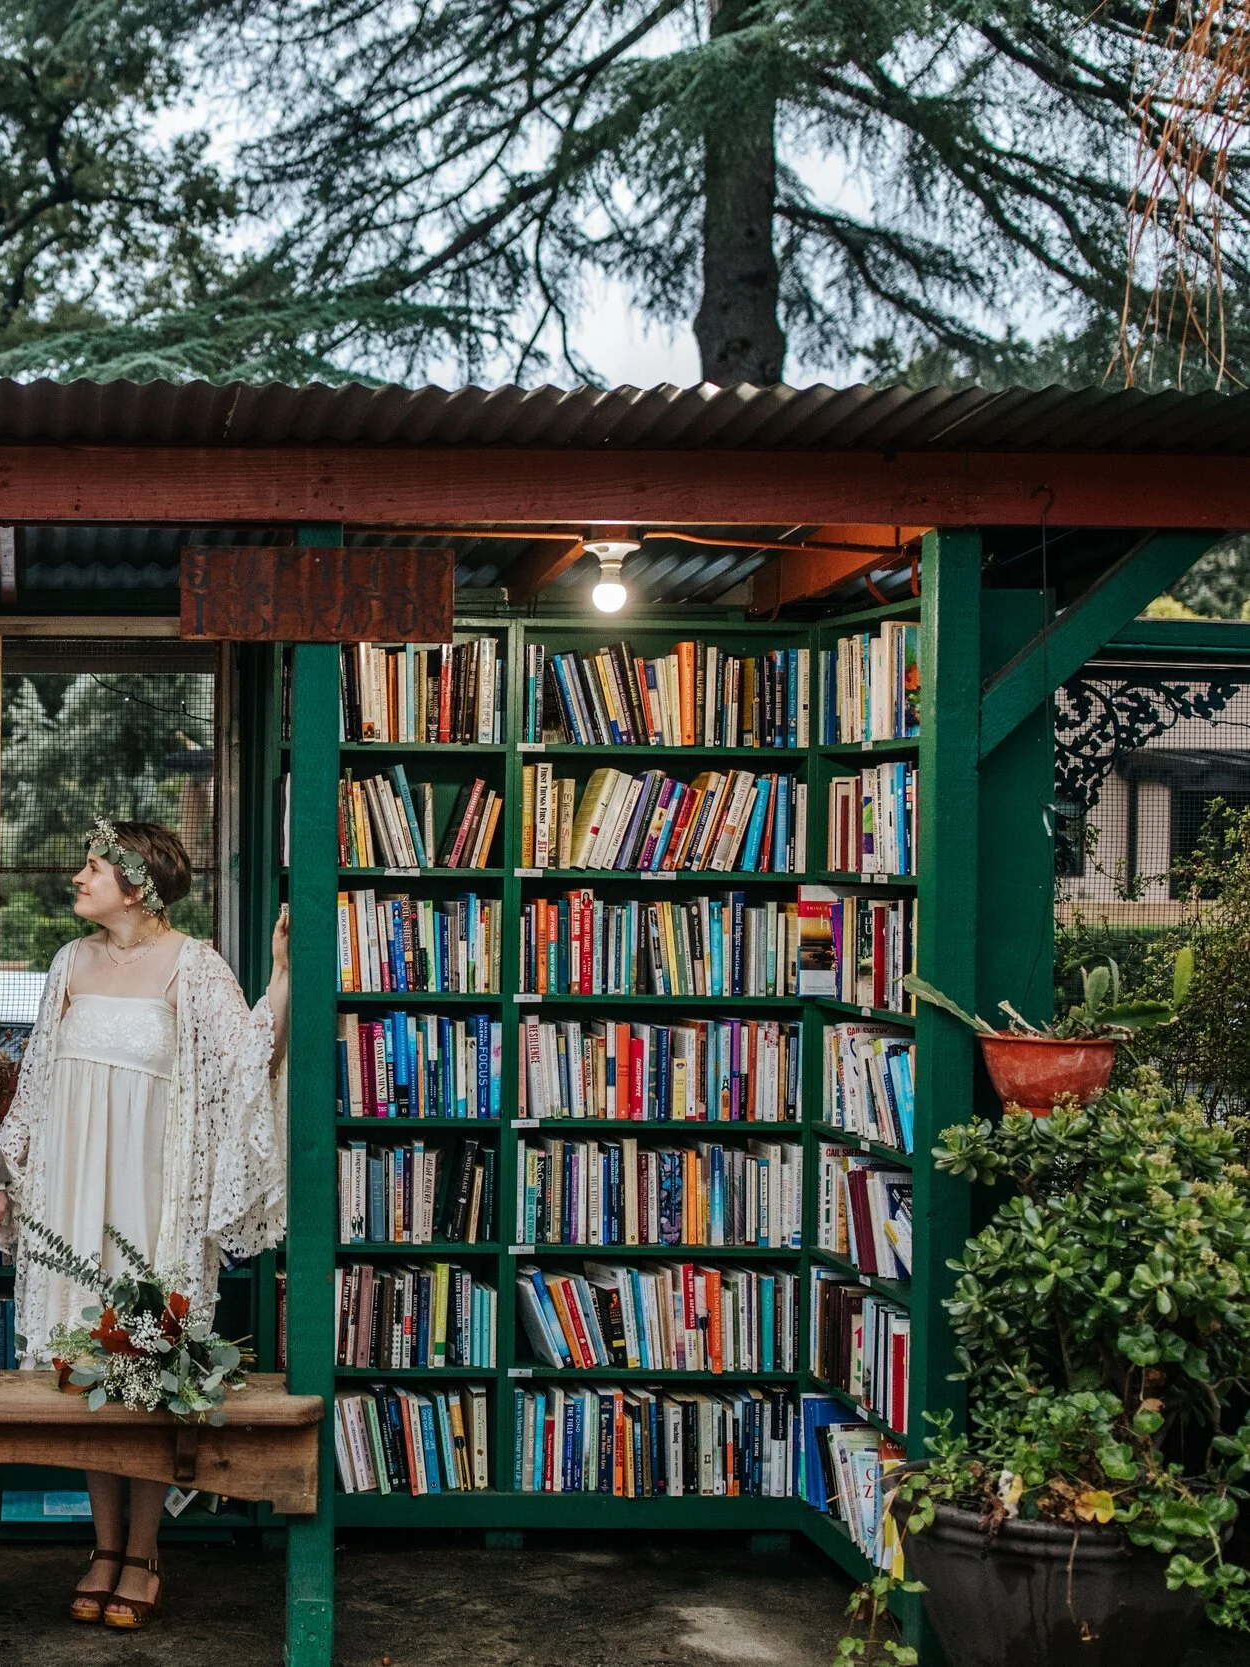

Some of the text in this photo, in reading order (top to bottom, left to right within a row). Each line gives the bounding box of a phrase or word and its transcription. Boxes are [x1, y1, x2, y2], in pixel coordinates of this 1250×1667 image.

[696, 670, 704, 705] WILLPOWER
[539, 767, 550, 825] FIRST THINGS FIRST
[561, 792, 573, 825] Effective
[731, 774, 750, 824] WALKING HOME
[400, 895, 411, 951] SOUL SHIFTS
[573, 898, 581, 914] MADE
[340, 908, 350, 965] SEDONA METHOD
[583, 910, 591, 953] BETHENNY FRANKEL
[528, 1024, 541, 1064] RESILIENCE
[376, 1042, 386, 1097] DAYDREAMING
[478, 1046, 488, 1086] FOCUS
[354, 1152, 362, 1165] Living
[537, 1161, 544, 1172] No
[825, 1148, 841, 1158] GAIL
[424, 1158, 434, 1204] HIGH ACHIEVER
[461, 1156, 473, 1194] WISE HEART
[536, 1172, 544, 1198] Contest
[623, 1299, 631, 1323] Advantage
[566, 1406, 574, 1435] THE FIELD
[672, 1422, 680, 1444] Touching
